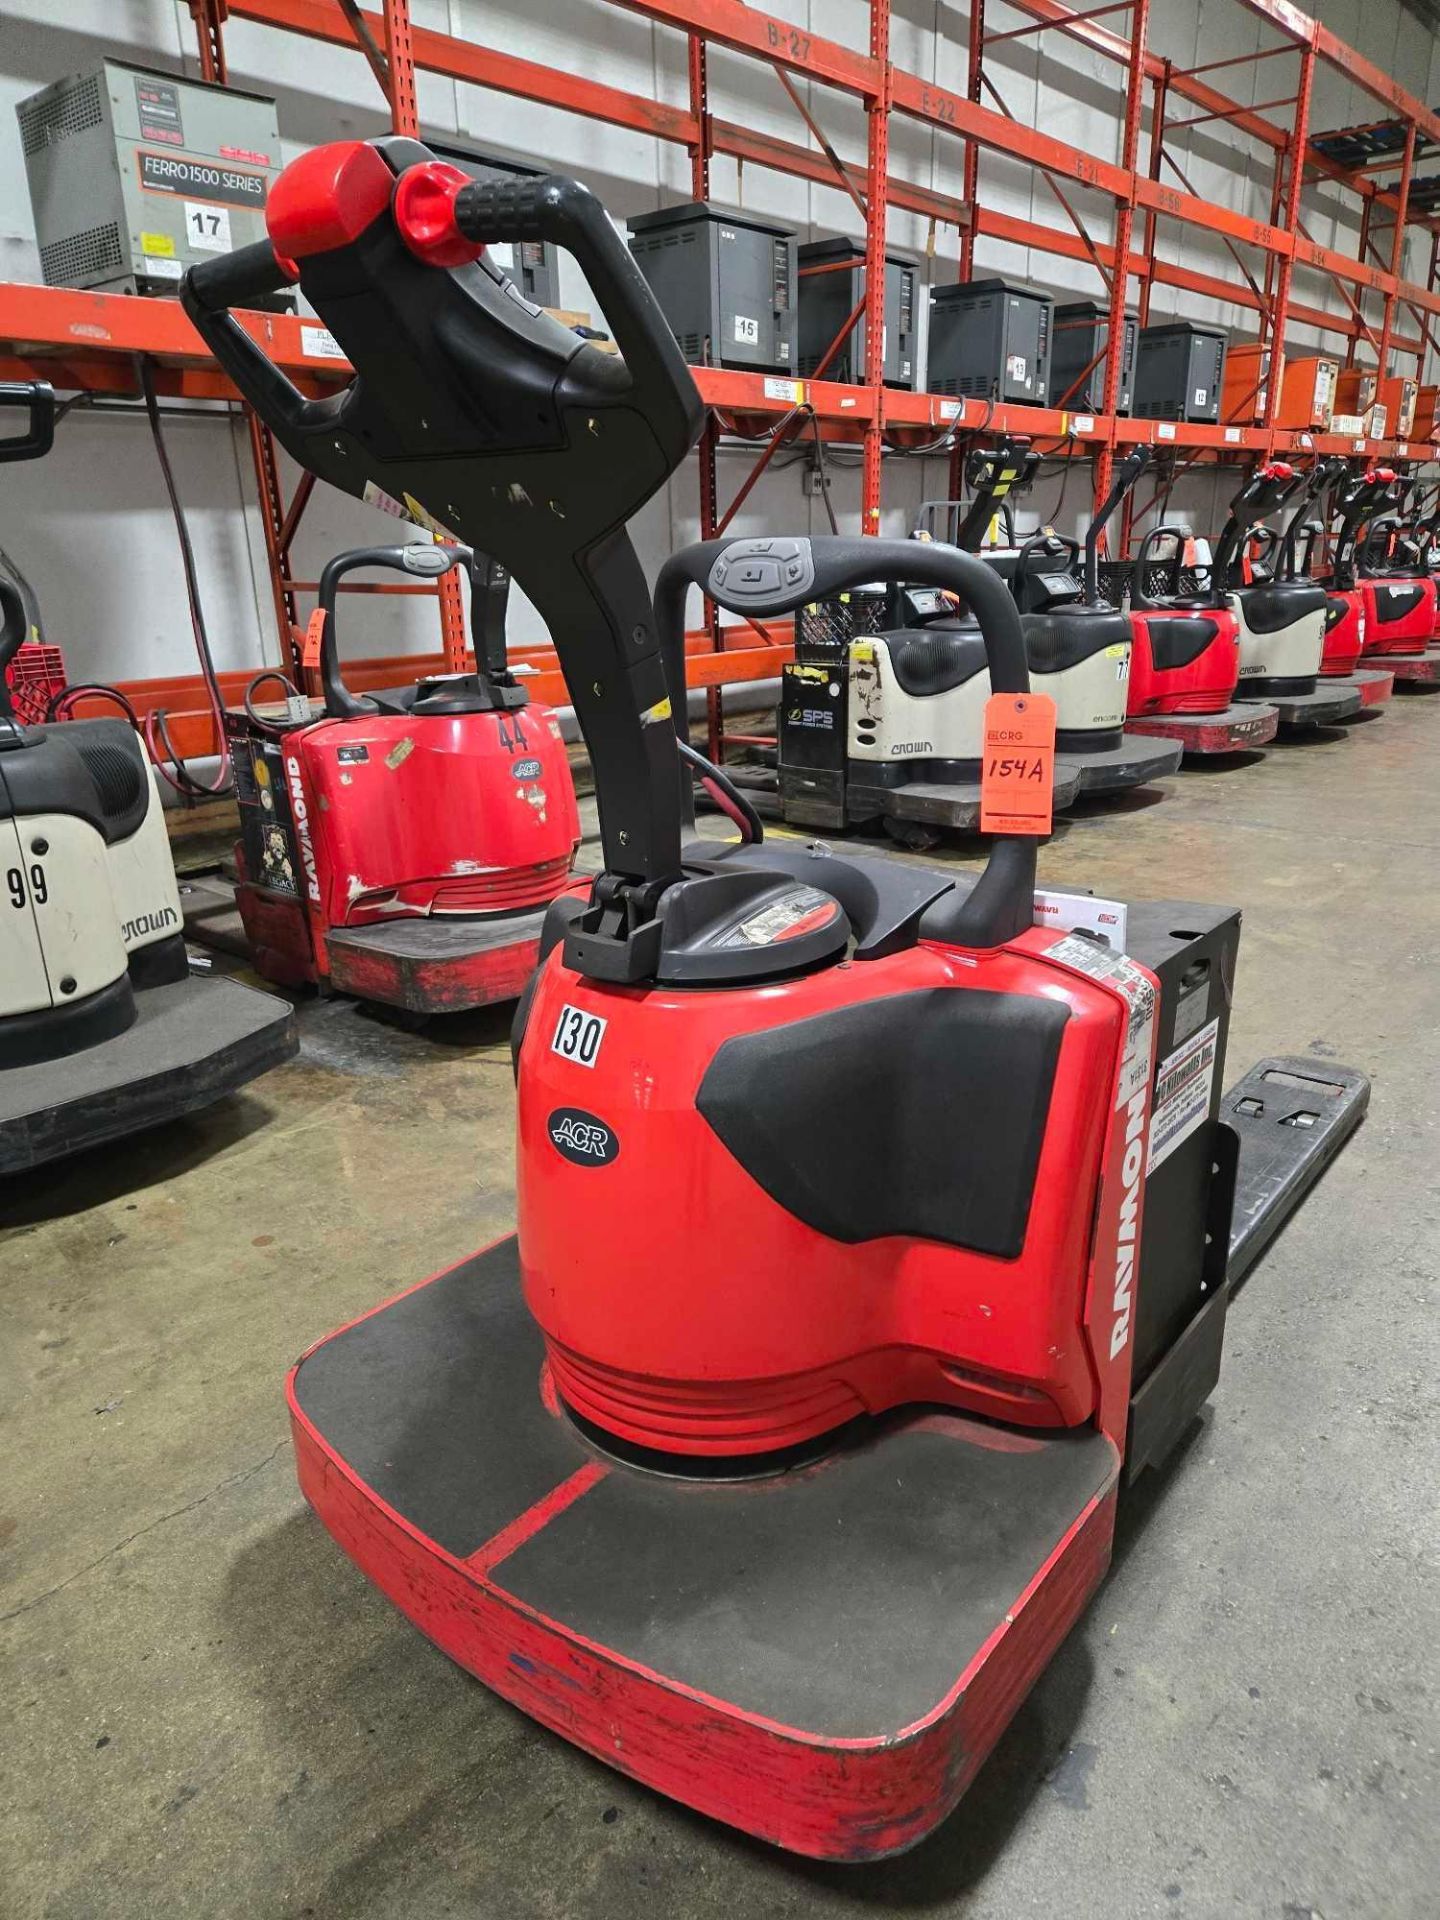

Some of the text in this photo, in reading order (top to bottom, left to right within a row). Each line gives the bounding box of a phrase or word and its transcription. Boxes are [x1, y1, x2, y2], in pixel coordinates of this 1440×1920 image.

[222, 171, 262, 194] SERIES
[191, 212, 221, 236] 17
[740, 319, 754, 337] 15
[802, 709, 834, 724] SPS
[498, 713, 529, 754] 44
[1000, 730, 1024, 740] CRG
[891, 742, 934, 755] CROWN
[989, 758, 1043, 783] 154A
[287, 756, 322, 901] RAYMOND
[7, 864, 48, 909] 99
[555, 1007, 602, 1063] 130
[552, 1117, 608, 1158] ACR
